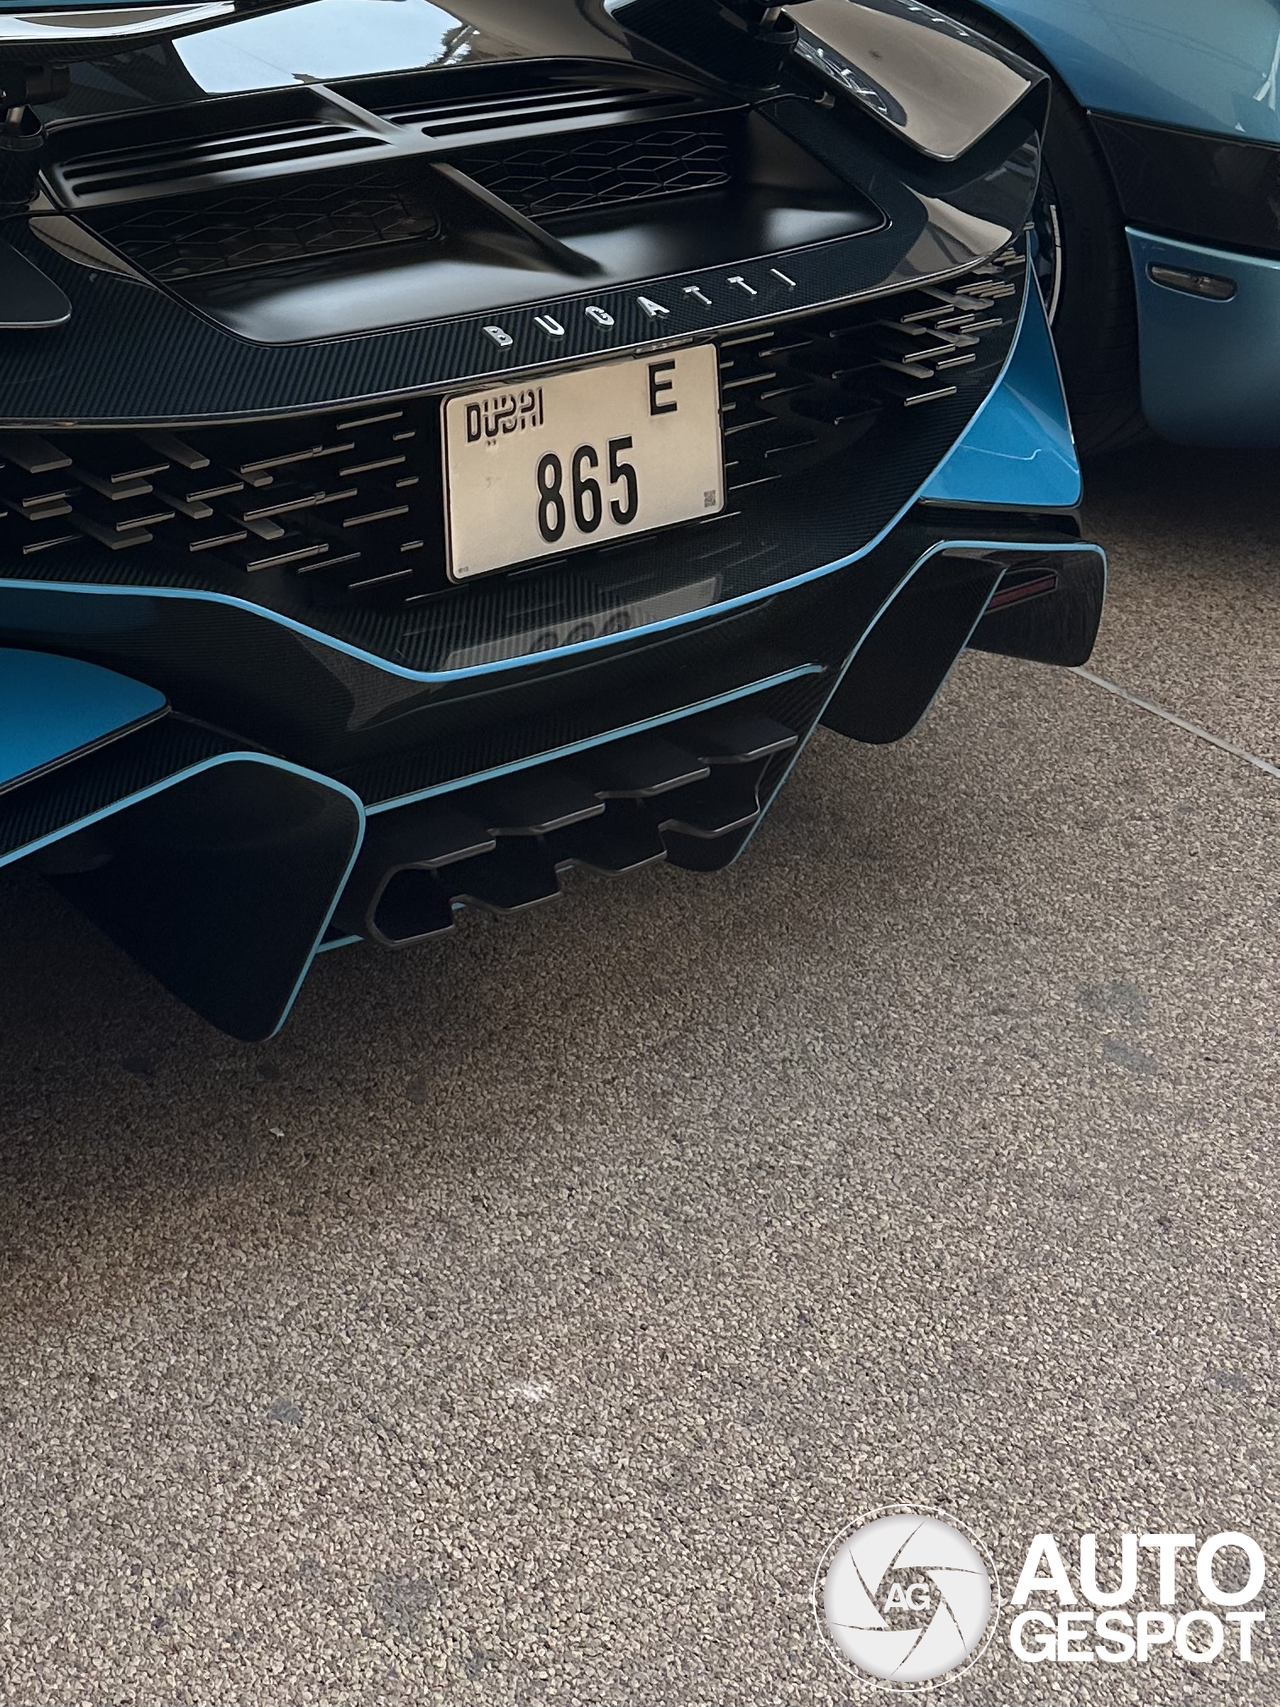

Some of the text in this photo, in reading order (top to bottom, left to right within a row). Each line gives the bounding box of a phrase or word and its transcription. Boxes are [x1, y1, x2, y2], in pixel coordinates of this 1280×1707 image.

[483, 268, 797, 348] BUGATTI
[648, 358, 679, 417] E
[536, 434, 639, 544] 865
